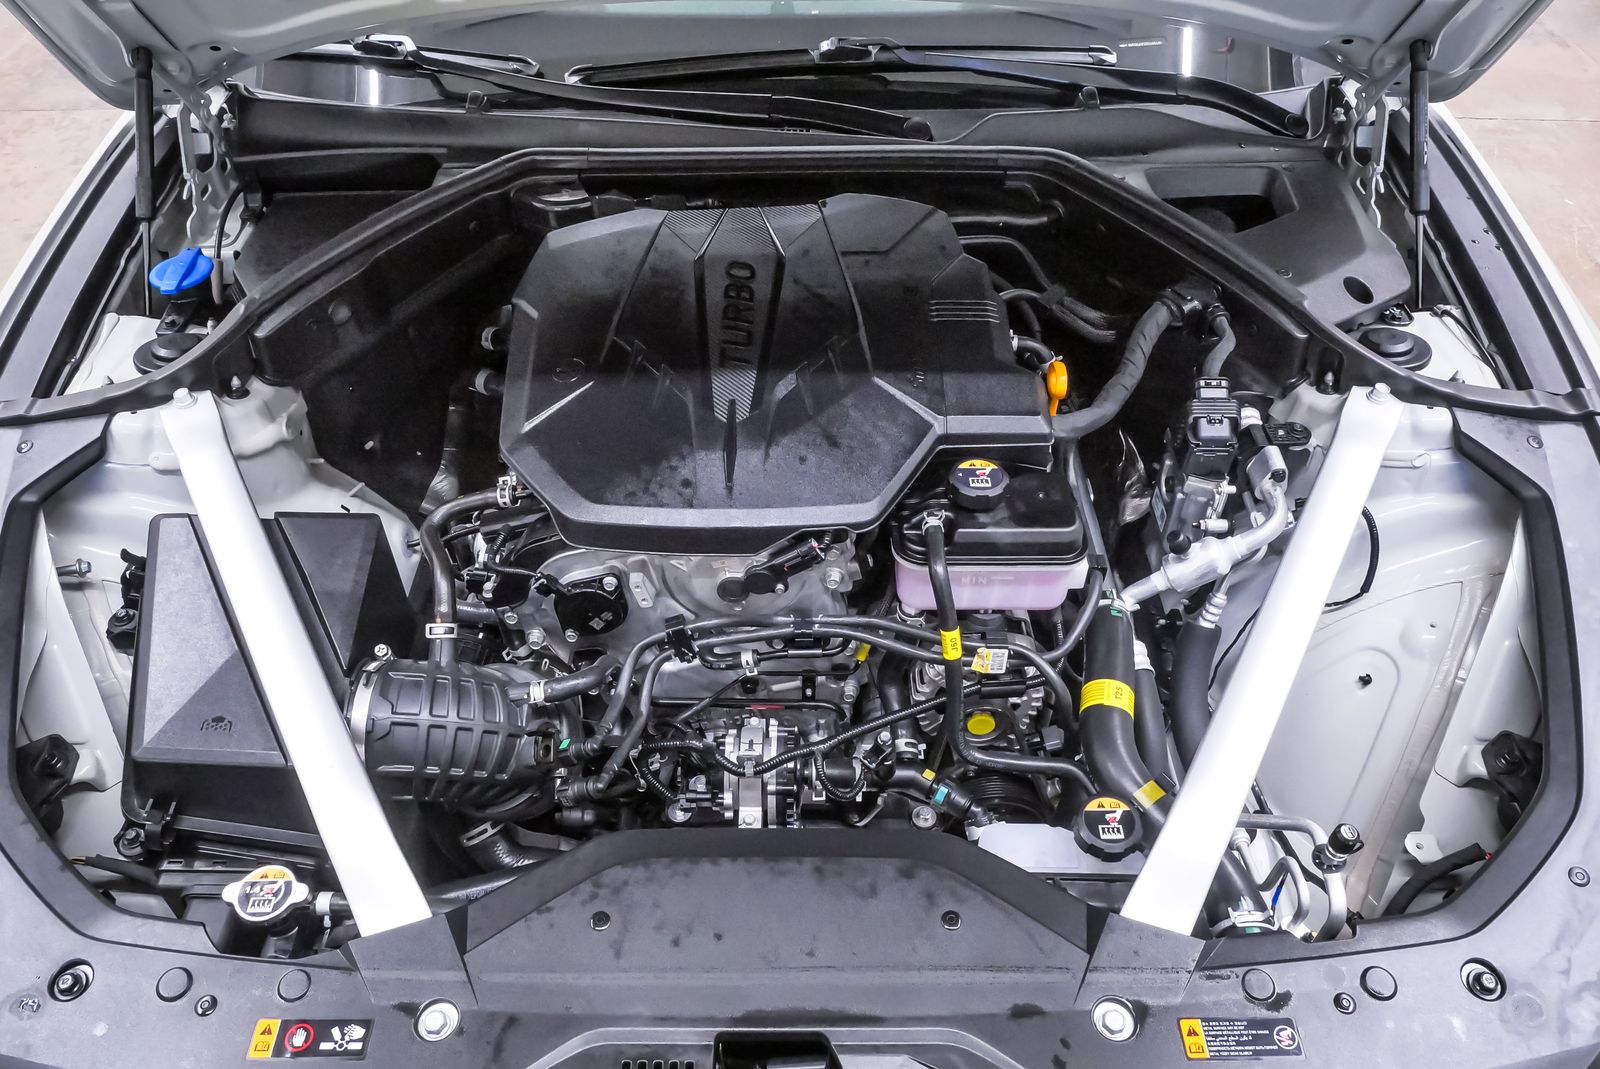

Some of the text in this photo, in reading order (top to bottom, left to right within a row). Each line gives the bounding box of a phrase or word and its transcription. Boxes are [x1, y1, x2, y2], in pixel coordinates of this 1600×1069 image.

[719, 260, 756, 368] TURBO
[961, 576, 987, 585] MIN
[1115, 686, 1123, 700] T25
